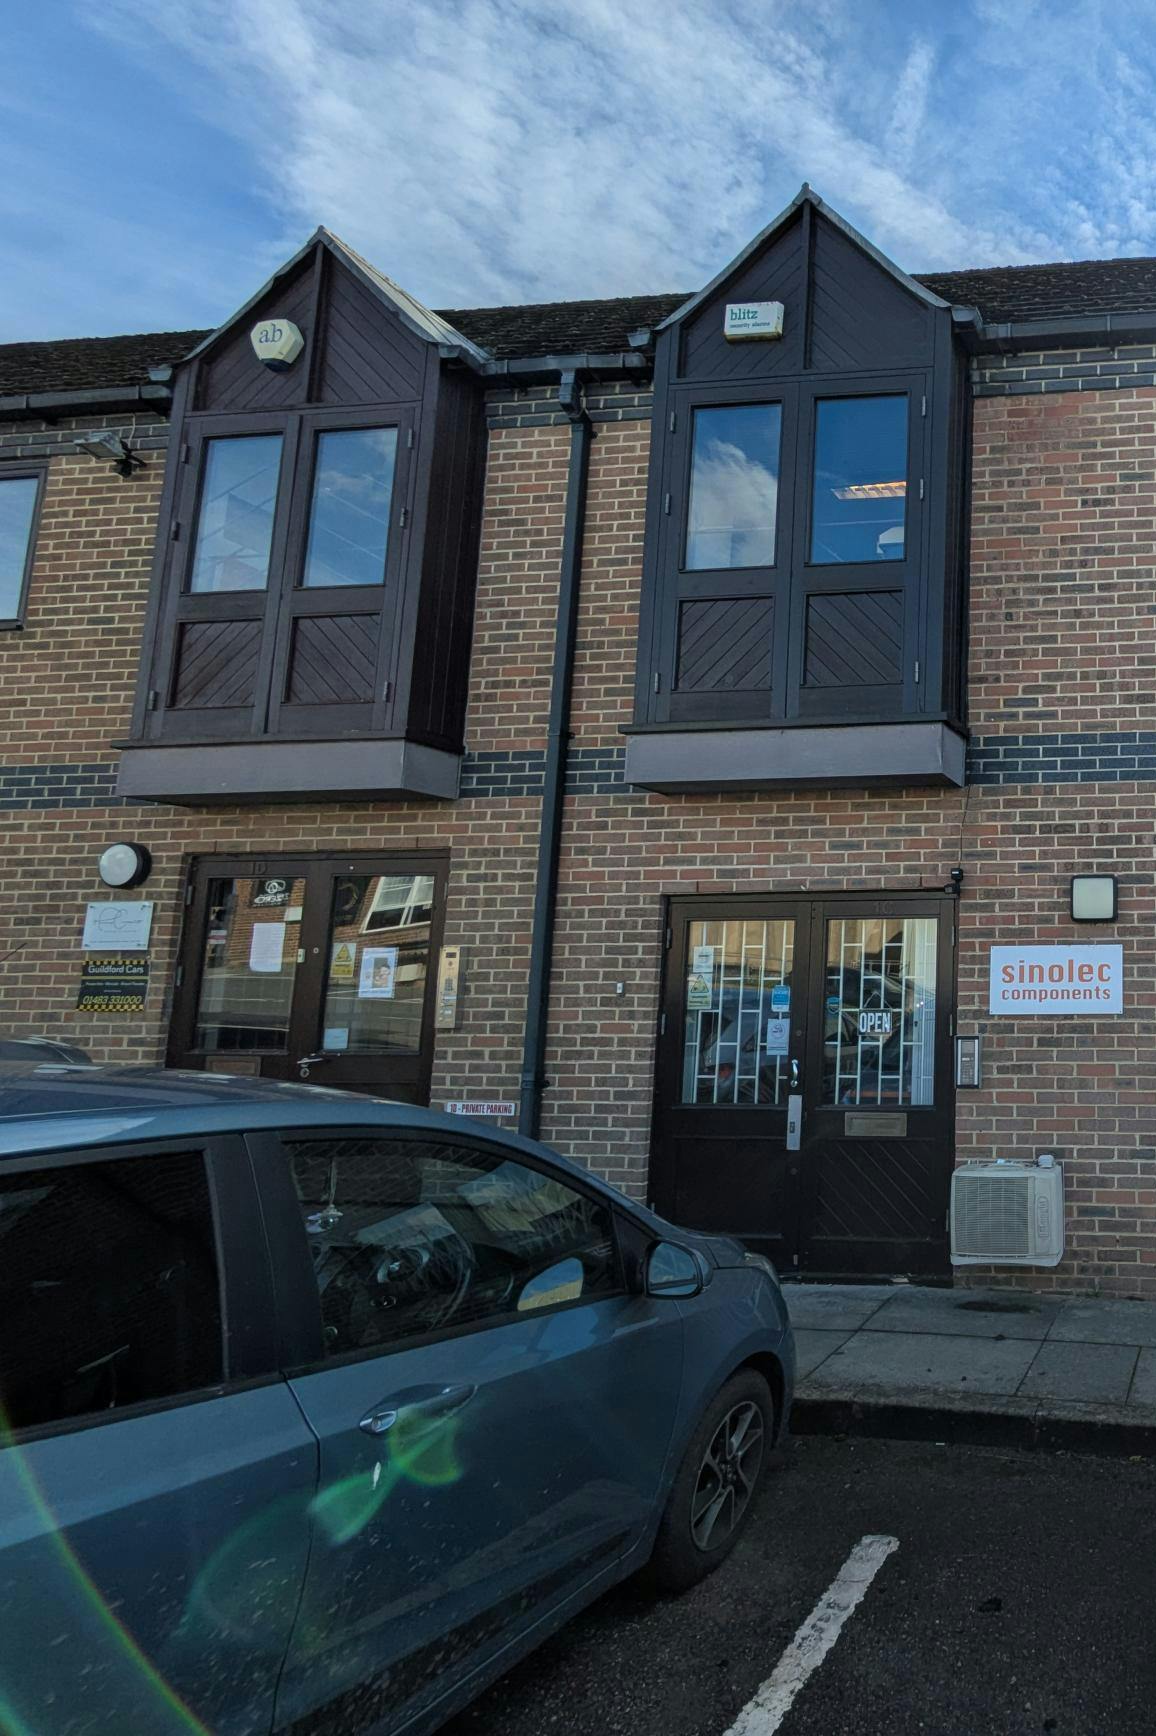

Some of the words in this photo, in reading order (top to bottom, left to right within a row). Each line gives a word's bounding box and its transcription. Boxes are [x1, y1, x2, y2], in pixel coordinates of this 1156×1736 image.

[730, 308, 758, 320] blitz
[259, 322, 283, 343] ab
[88, 964, 124, 973] Guildford
[125, 964, 144, 973] Cars
[1002, 960, 1111, 984] sinolec
[1002, 986, 1111, 1002] components
[859, 1012, 890, 1033] OPEN
[461, 1103, 486, 1113] PRIVATE
[486, 1104, 513, 1114] PARKING
